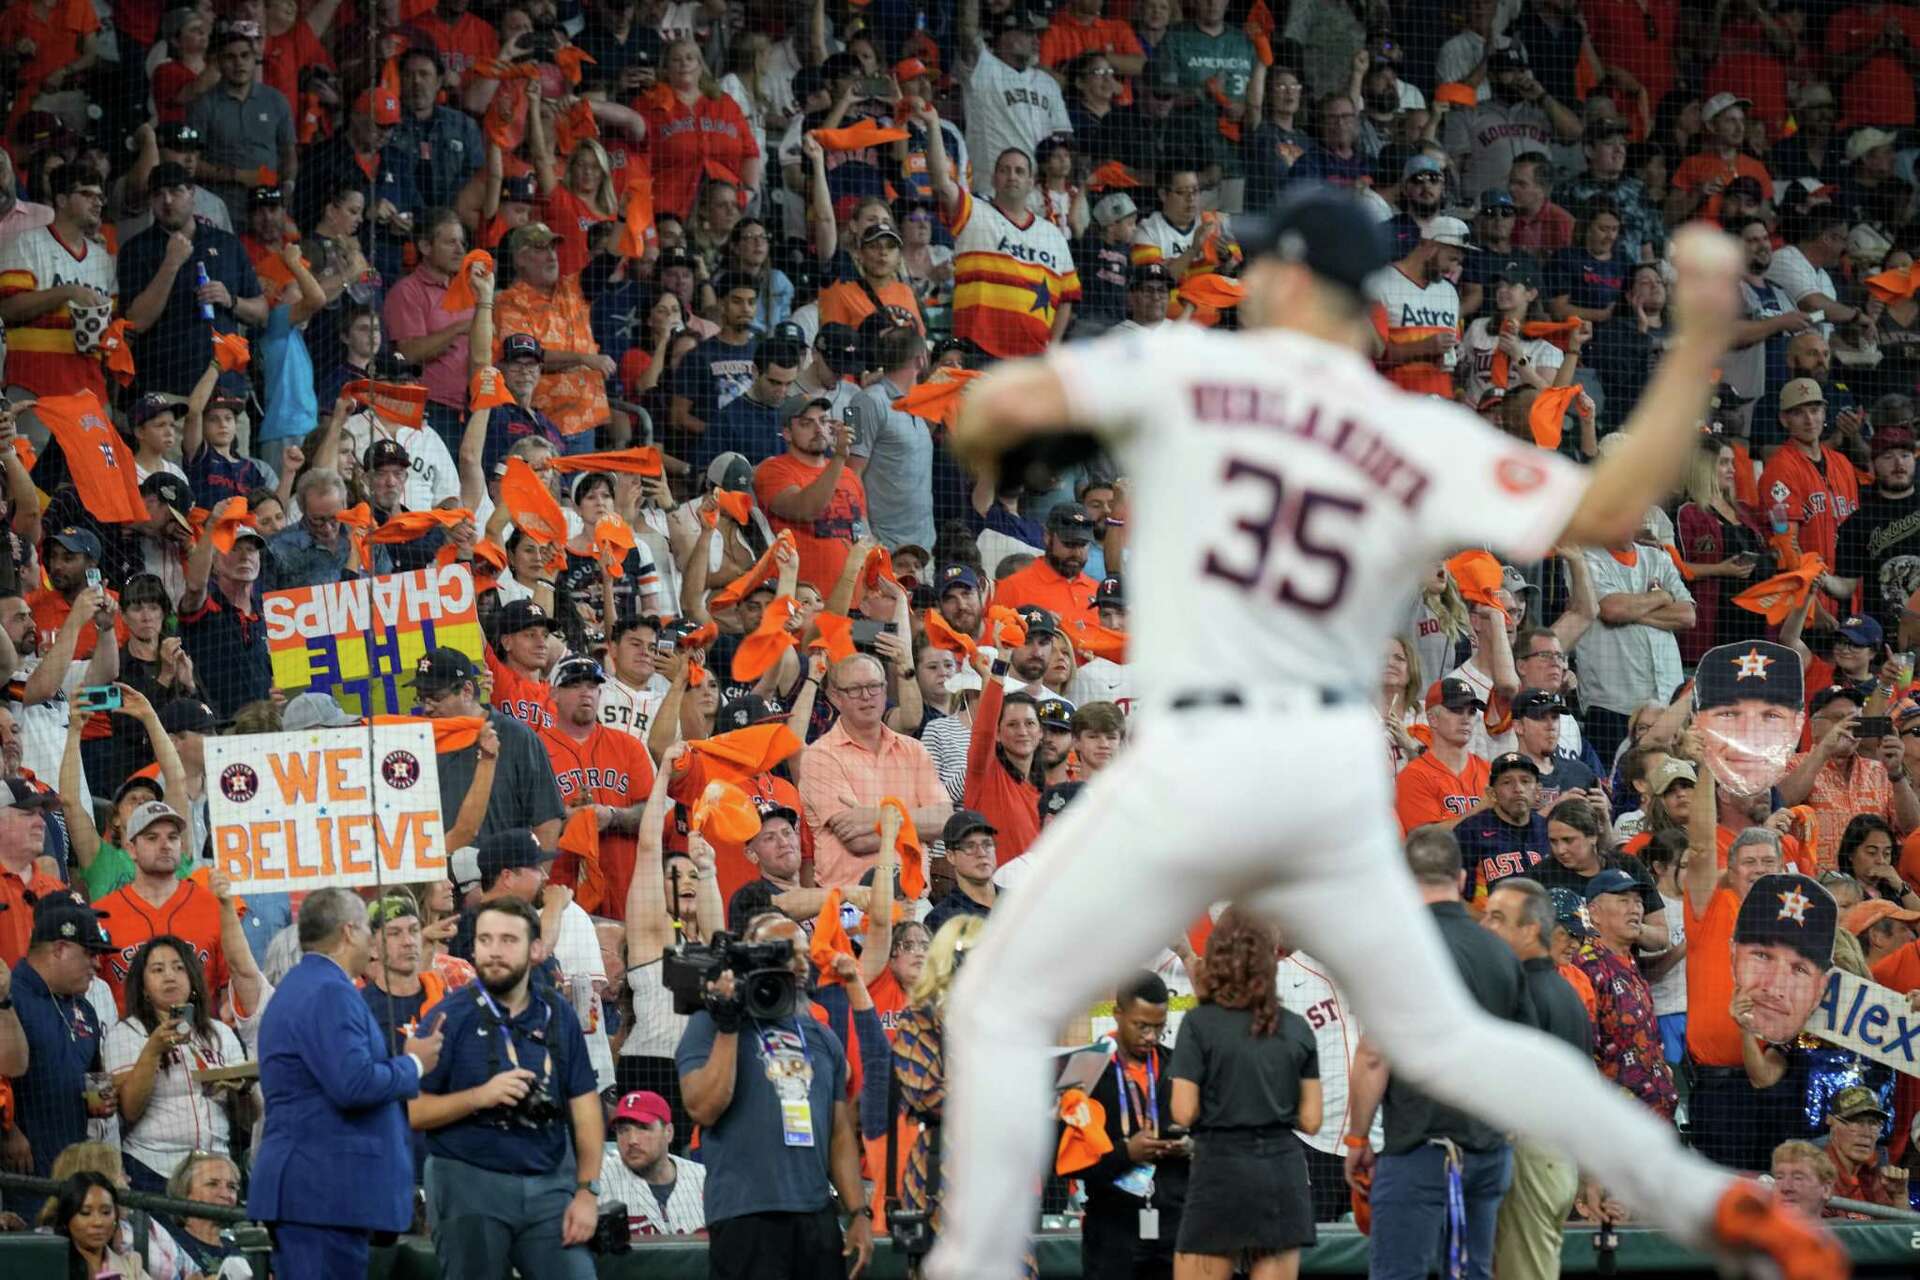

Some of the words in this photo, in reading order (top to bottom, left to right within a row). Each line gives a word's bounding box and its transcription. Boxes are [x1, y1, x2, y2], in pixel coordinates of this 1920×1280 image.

[1478, 124, 1551, 147] HOUSTON
[1203, 456, 1366, 612] 35
[262, 562, 475, 641] CHAMPS
[596, 705, 650, 732] STR
[267, 747, 367, 806] WE
[215, 810, 446, 882] BELIEVE
[1305, 998, 1338, 1030] ST
[1813, 971, 1920, 1062] Alex
